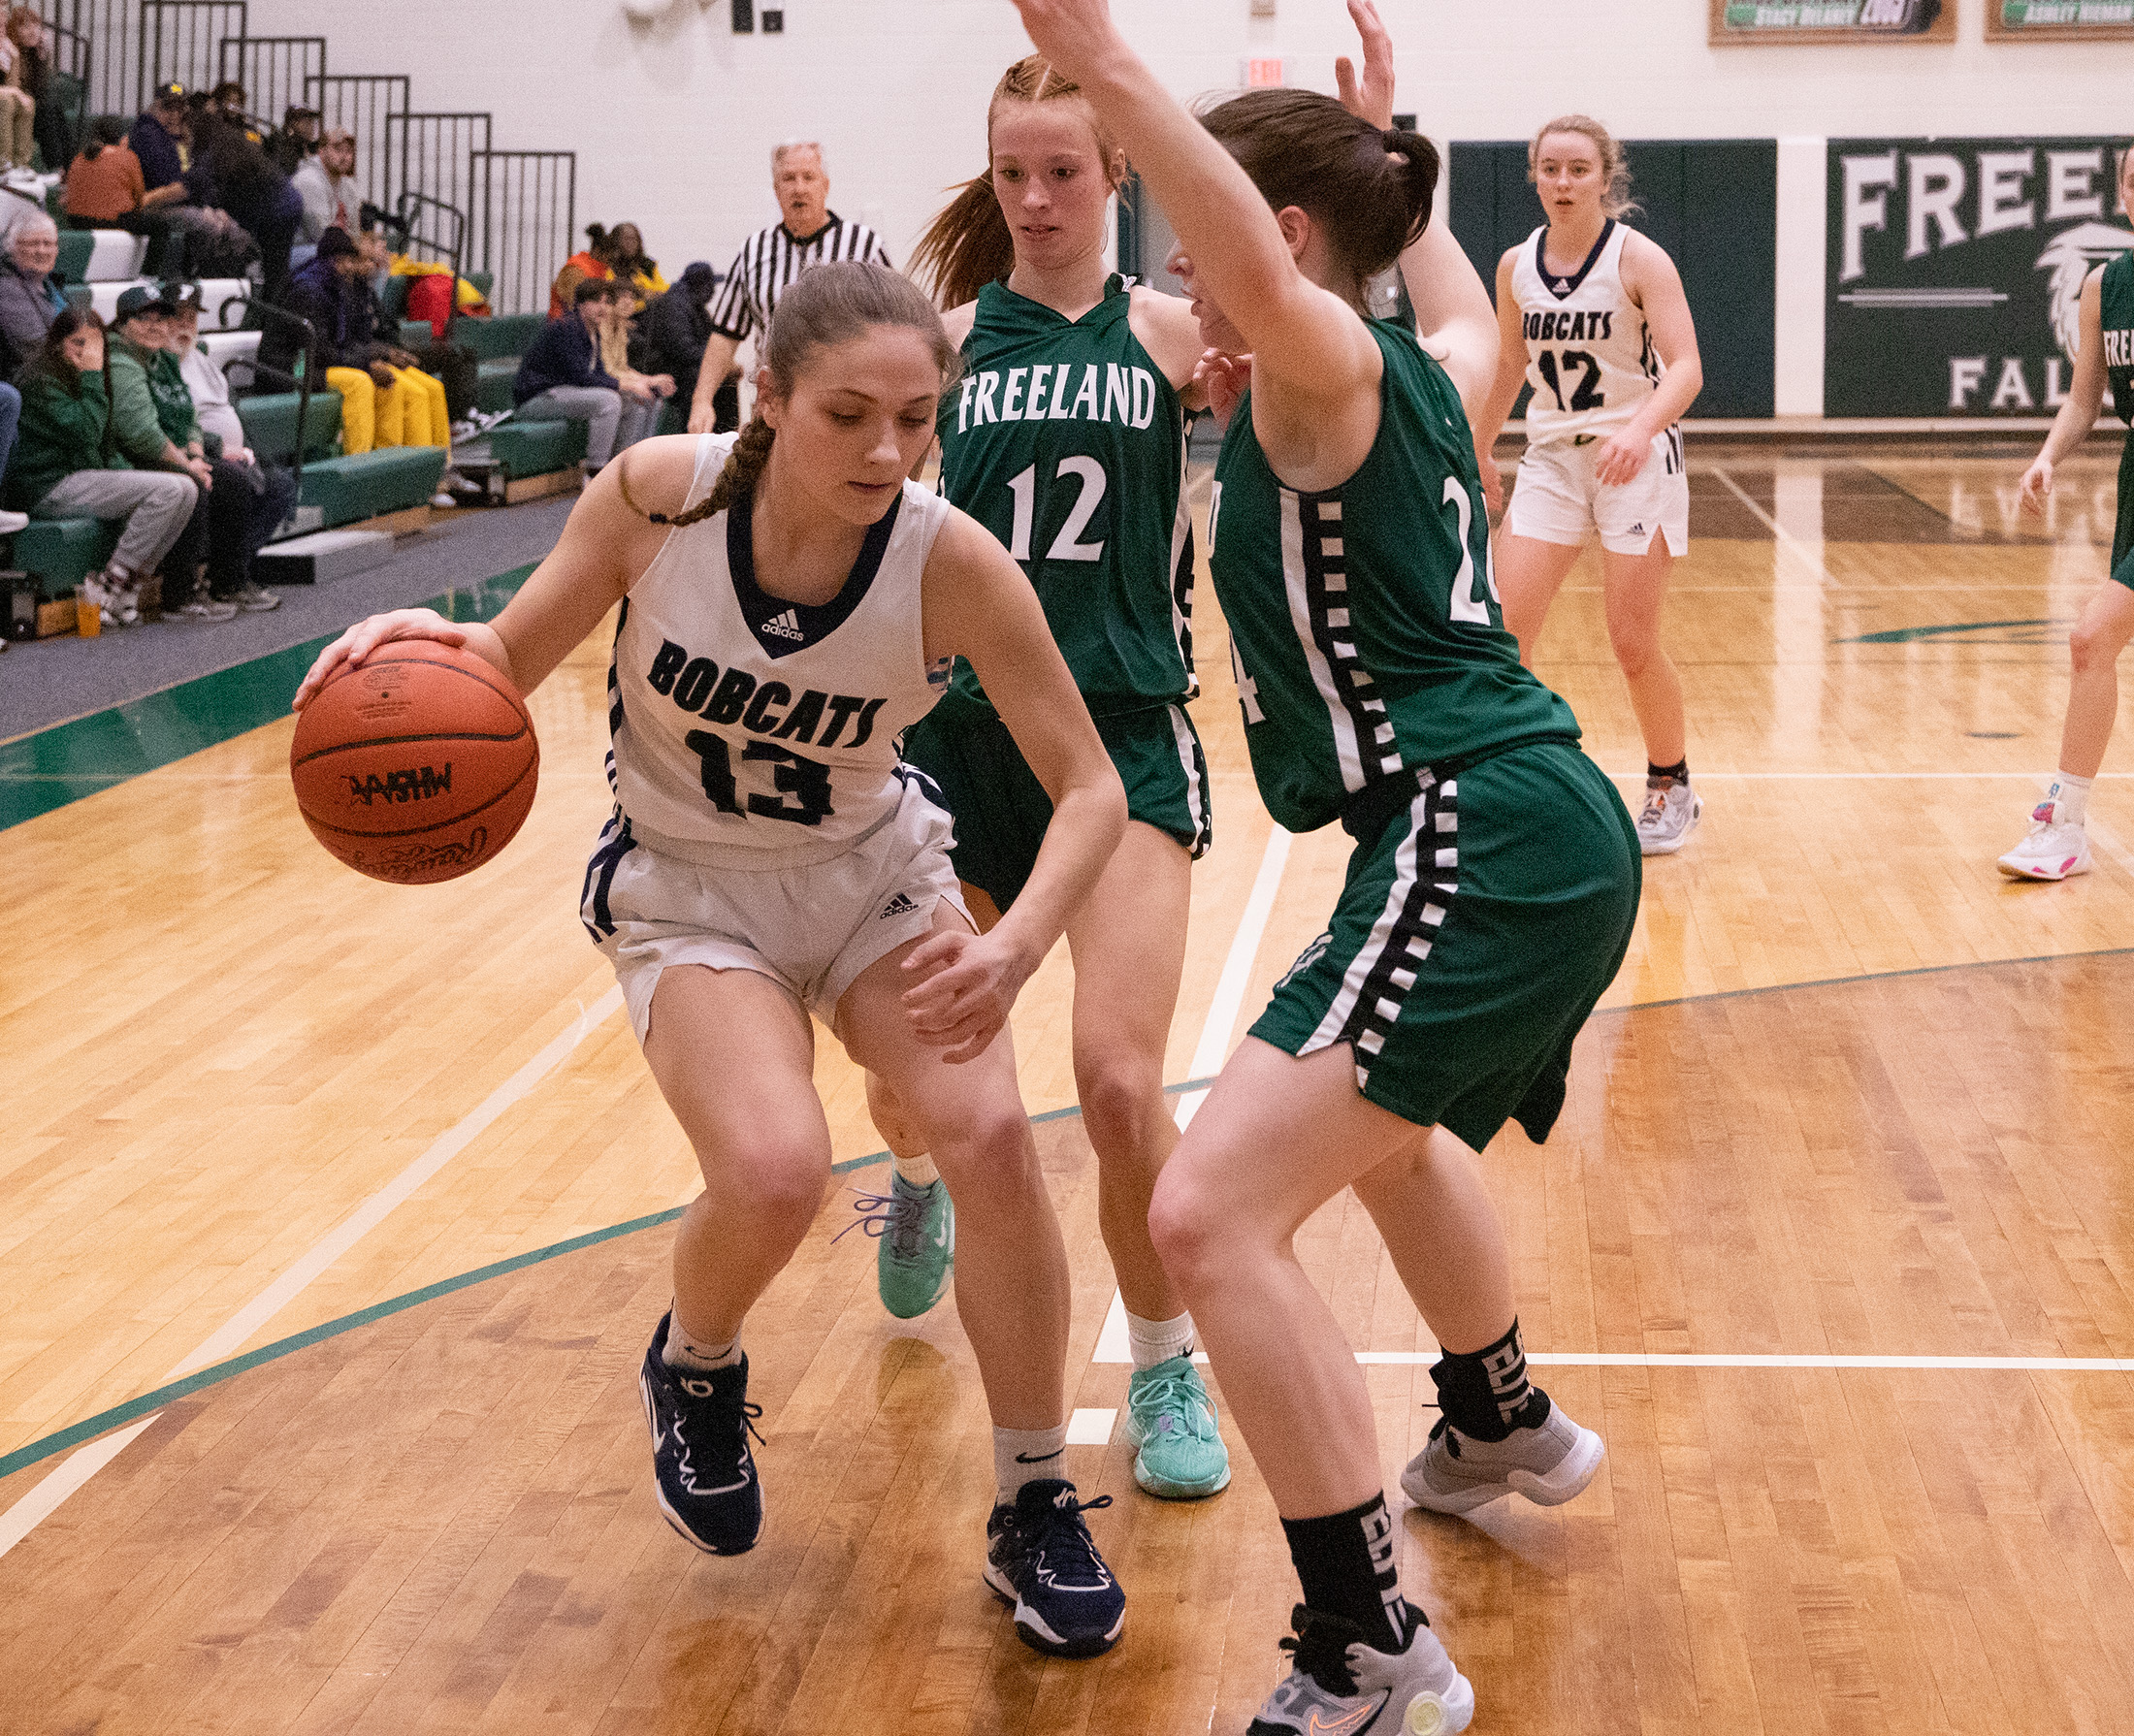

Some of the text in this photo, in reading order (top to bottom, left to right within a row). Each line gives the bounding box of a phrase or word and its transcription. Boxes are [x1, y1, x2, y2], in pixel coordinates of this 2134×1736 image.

[1538, 349, 1605, 412] 12
[2103, 330, 2134, 367] FRE
[957, 363, 1156, 434] FREELAND
[1949, 357, 2115, 409] FAL
[1006, 455, 1107, 562] 12
[1442, 475, 1502, 627] 2
[760, 623, 805, 642] adidas
[647, 638, 888, 749] BOBCATS
[341, 762, 452, 806] MHSAA
[685, 728, 835, 825] 13
